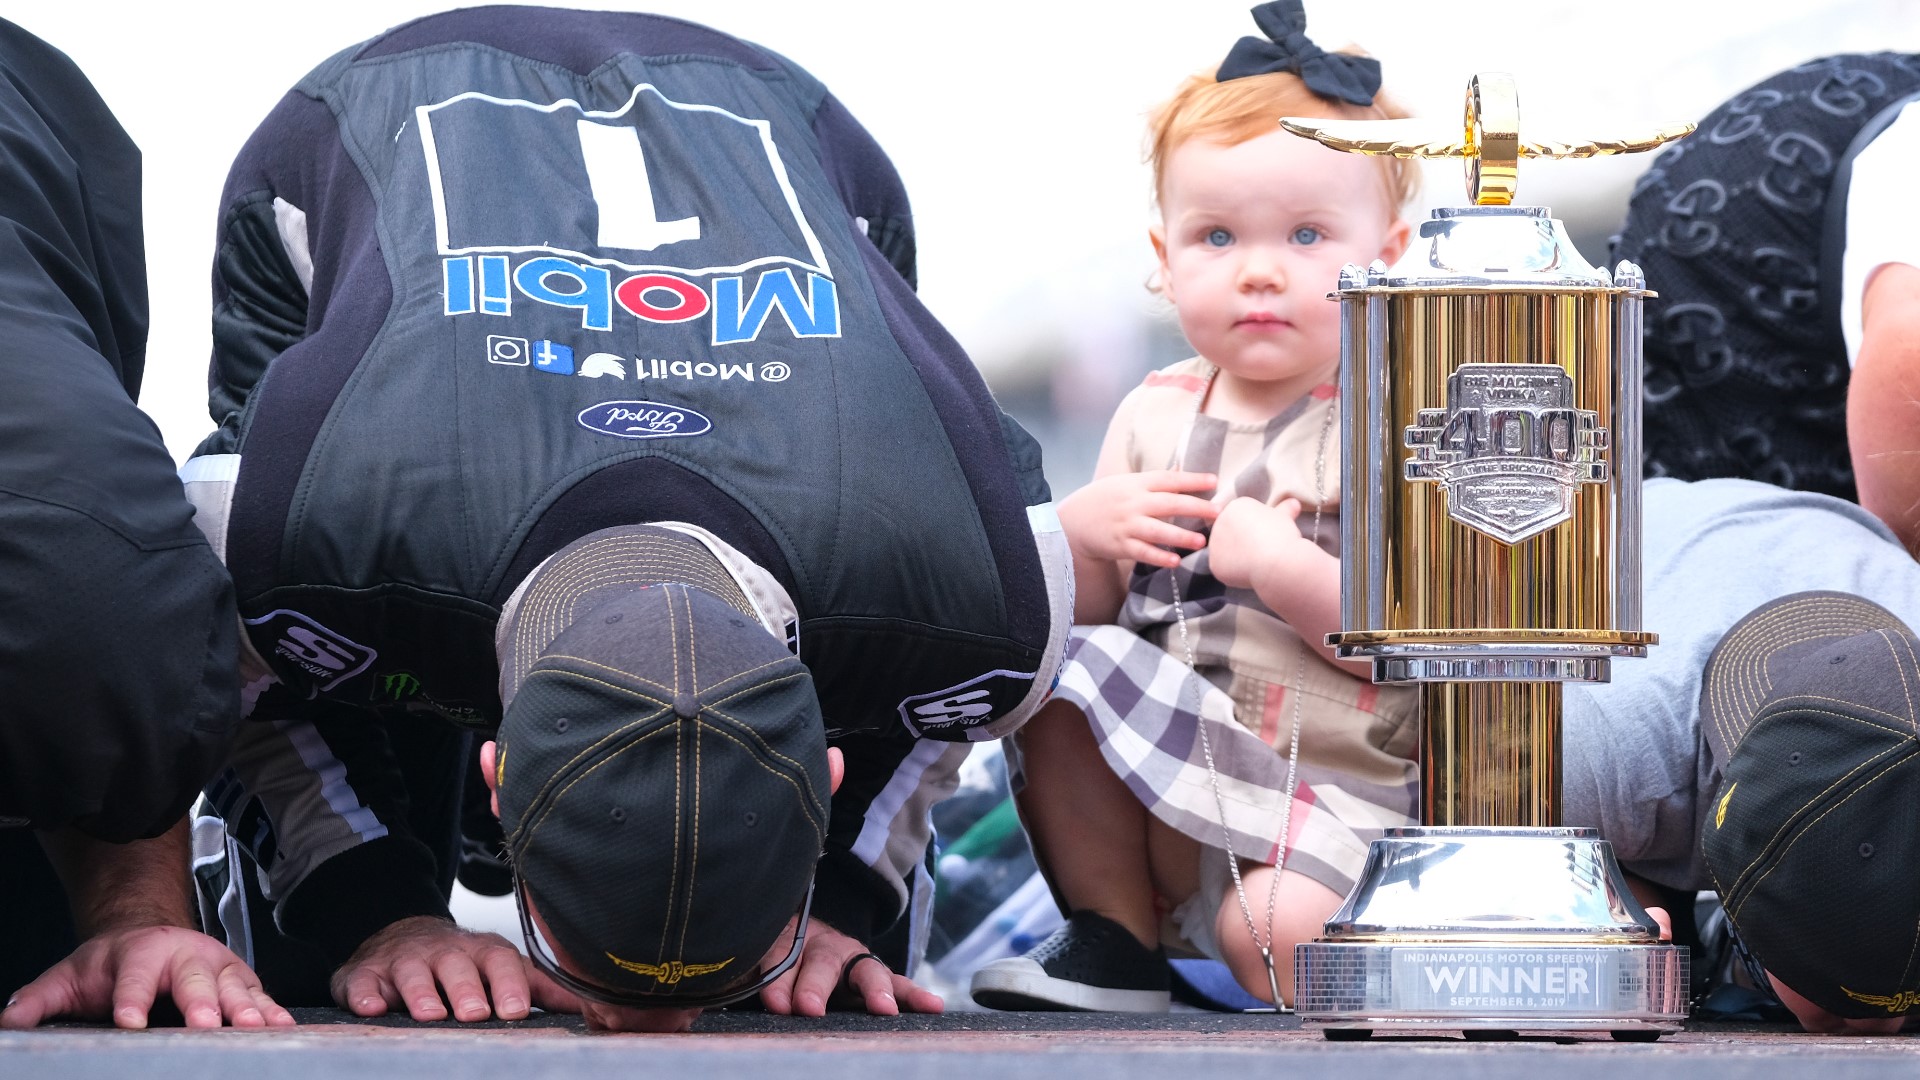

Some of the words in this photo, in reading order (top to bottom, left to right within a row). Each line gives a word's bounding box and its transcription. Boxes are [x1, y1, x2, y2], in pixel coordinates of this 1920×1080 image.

[577, 119, 700, 251] 1
[443, 256, 842, 346] Mobil
[636, 358, 792, 382] @Mobil1
[1464, 374, 1489, 386] BIG
[1491, 374, 1559, 387] MACHINE
[1486, 387, 1537, 400] VODKA
[605, 406, 685, 433] Ford
[1434, 407, 1578, 457] 400
[1404, 953, 1493, 963] INDIANAPOLIS
[1499, 953, 1543, 963] MOTOR
[1547, 954, 1608, 964] SPEEDWAY
[1424, 966, 1590, 994] WINNER
[1450, 997, 1523, 1007] SEPTEMBER
[1527, 997, 1537, 1007] 8,
[1540, 997, 1565, 1007] 2019
